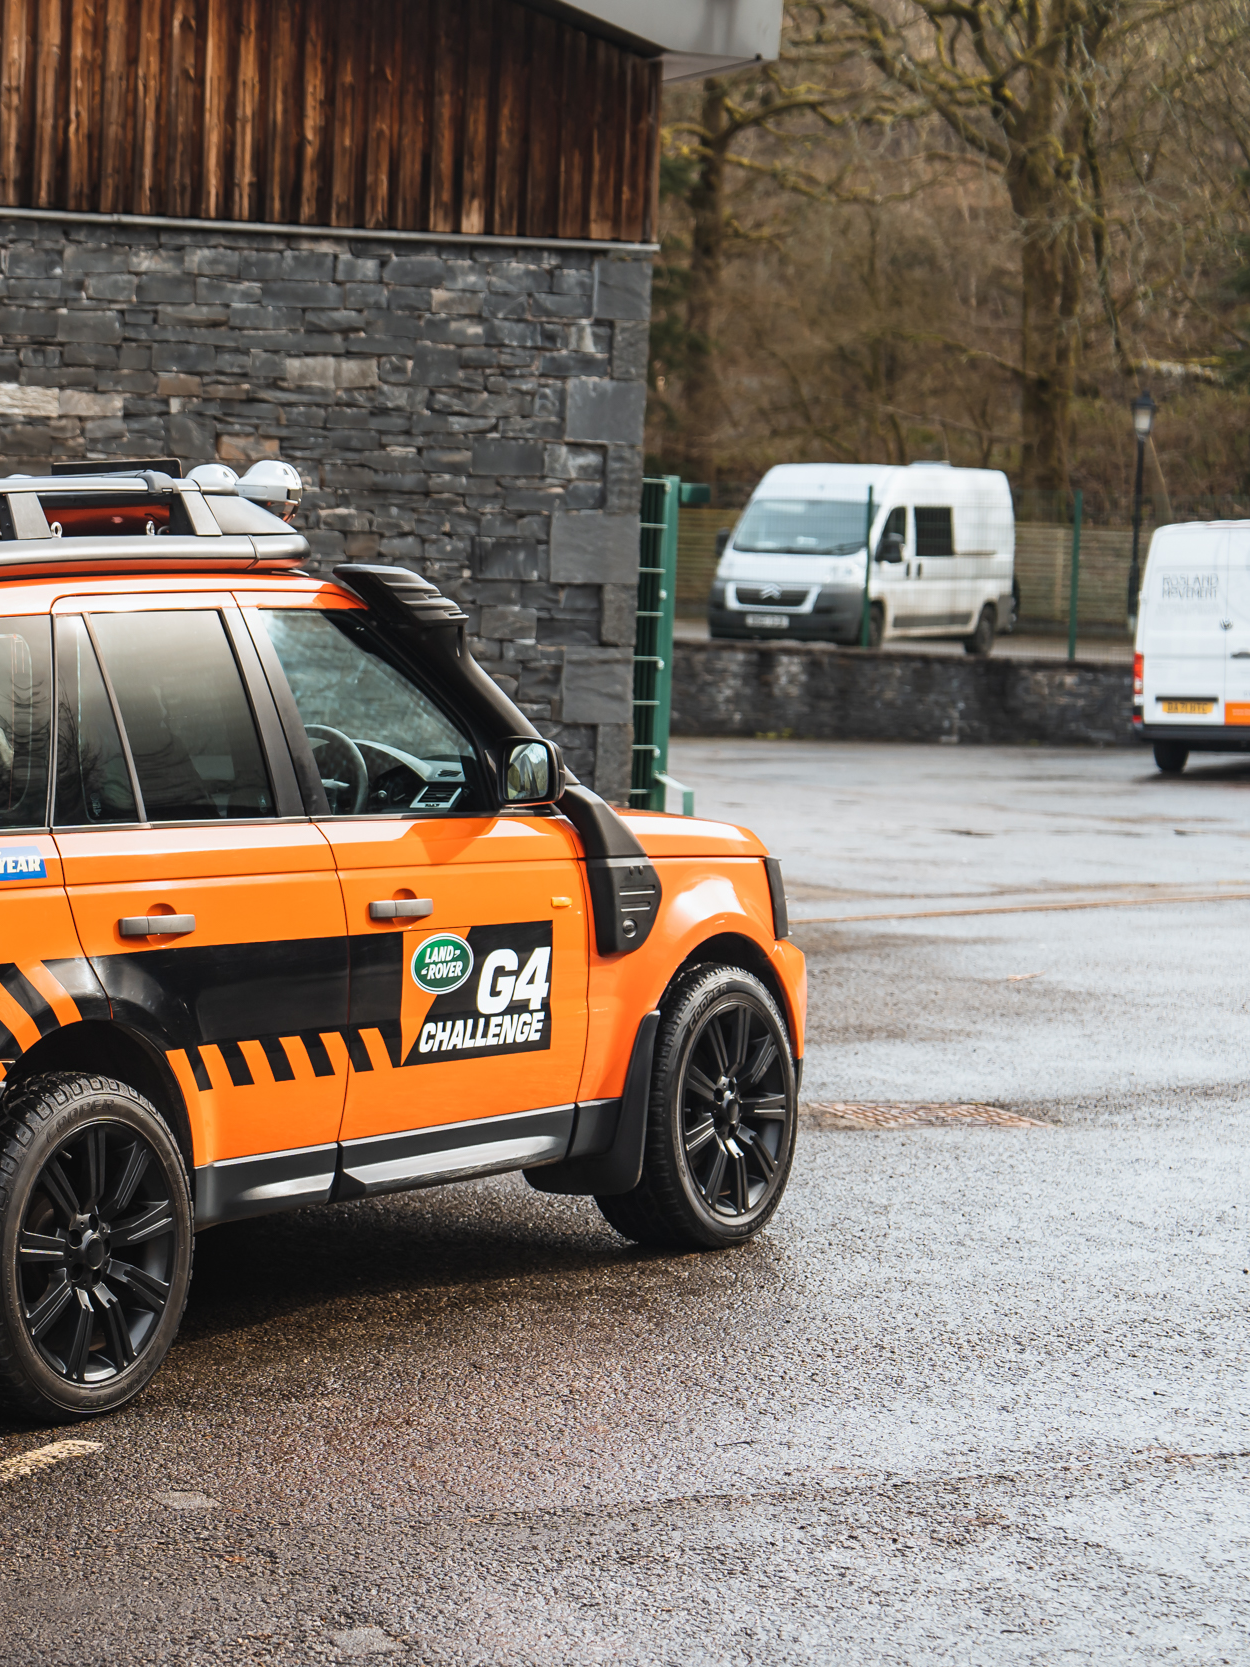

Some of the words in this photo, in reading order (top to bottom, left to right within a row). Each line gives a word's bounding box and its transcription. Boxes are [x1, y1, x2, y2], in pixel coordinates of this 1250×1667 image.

[476, 946, 551, 1015] G4
[689, 983, 727, 1031] COOPER
[418, 1012, 546, 1053] CHALLENGE
[45, 1098, 115, 1143] COOPER
